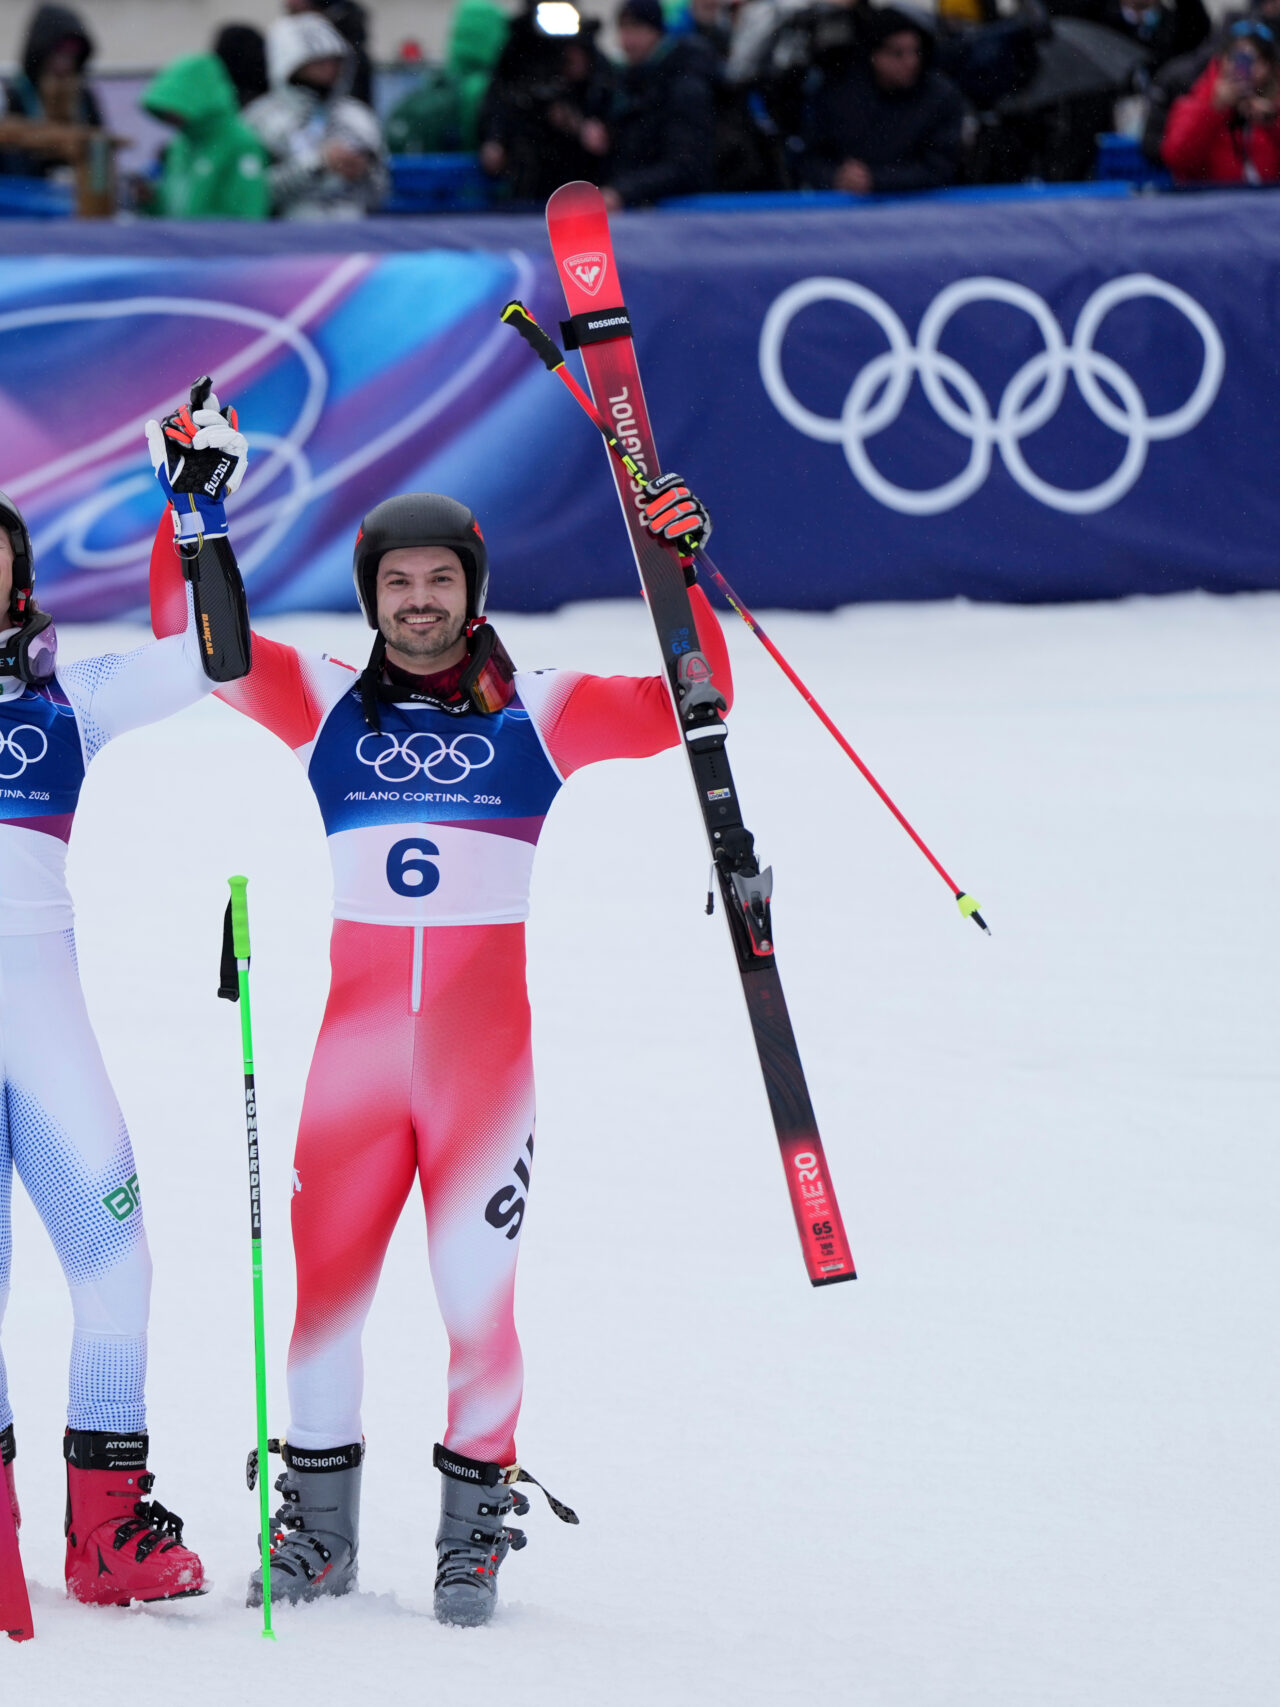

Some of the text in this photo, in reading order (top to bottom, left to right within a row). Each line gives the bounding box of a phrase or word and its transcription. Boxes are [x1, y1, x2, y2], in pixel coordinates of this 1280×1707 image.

[569, 256, 601, 267] ROSSIGNOL
[588, 316, 630, 330] ROSSIGNOL
[204, 457, 231, 497] racing
[28, 791, 51, 801] 2026
[344, 791, 502, 805] MILANO CORTINA 2026
[386, 837, 440, 898] 6
[245, 1088, 261, 1228] KOMPERDELL
[812, 1221, 832, 1236] GS
[105, 1441, 144, 1449] ATOMIC
[292, 1454, 348, 1467] ROSSIGNOL
[438, 1457, 482, 1480] OSSIGNOL
